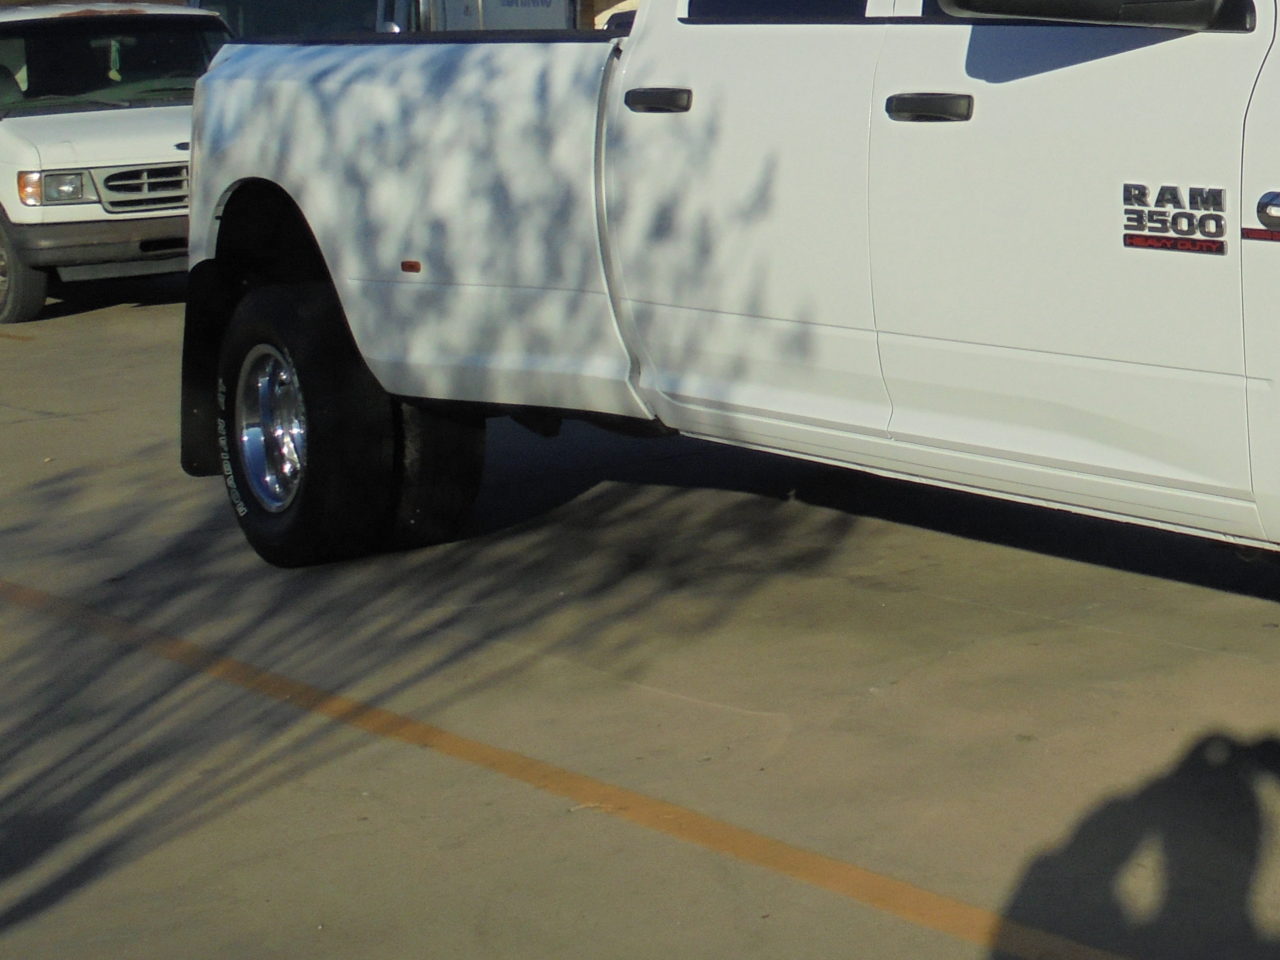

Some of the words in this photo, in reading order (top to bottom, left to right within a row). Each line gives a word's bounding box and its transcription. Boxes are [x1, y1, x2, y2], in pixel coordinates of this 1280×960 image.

[1123, 183, 1227, 212] RAM
[1123, 209, 1227, 238] 3500
[1126, 236, 1174, 249] HEAVY
[1177, 241, 1221, 253] DUTY
